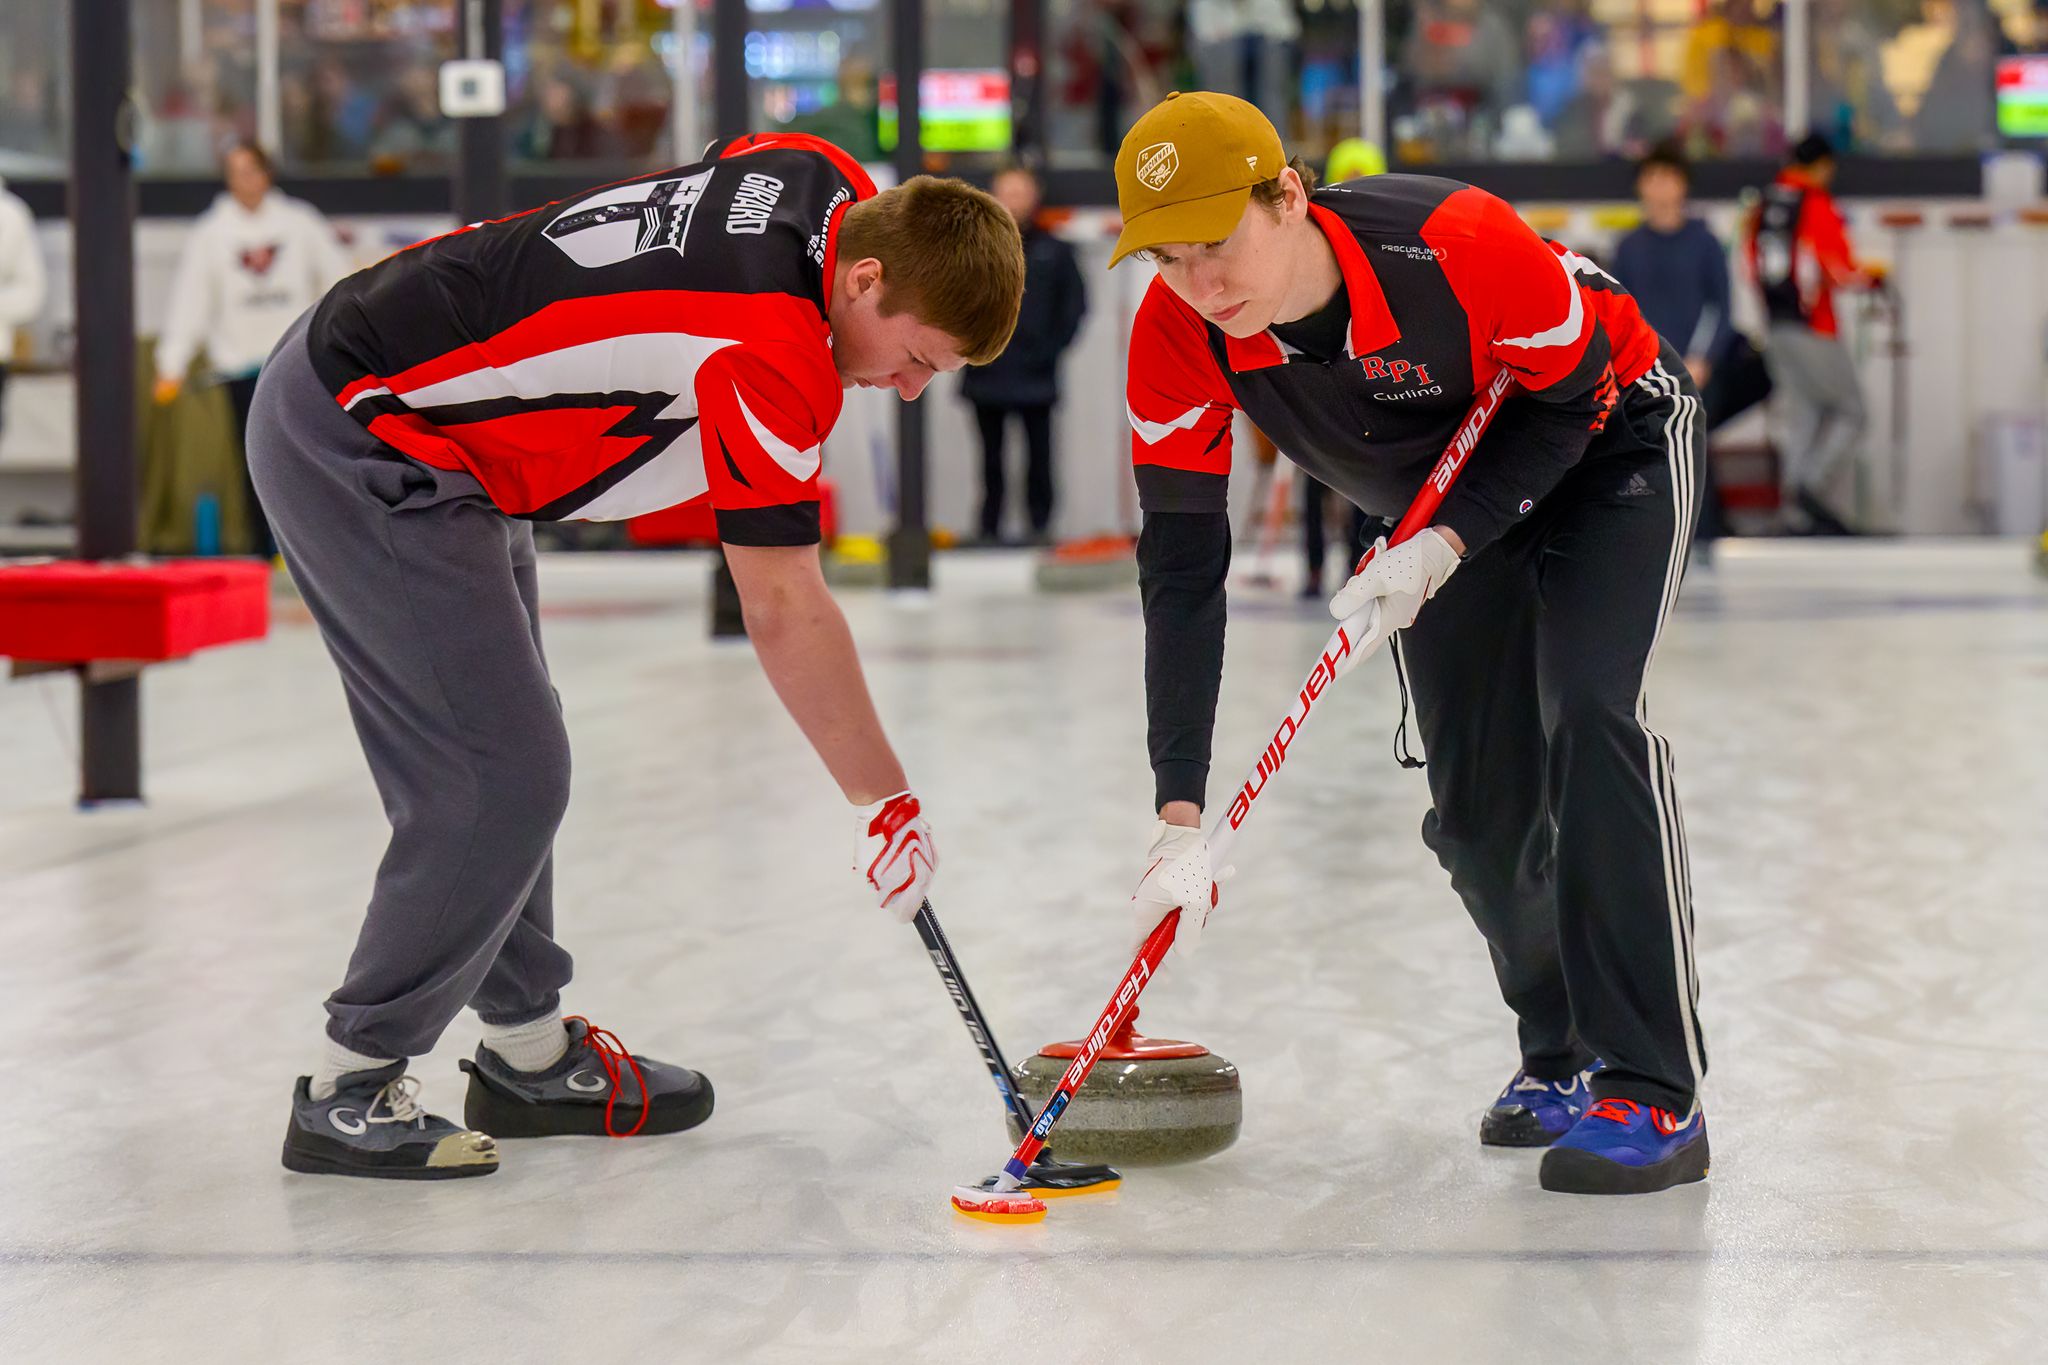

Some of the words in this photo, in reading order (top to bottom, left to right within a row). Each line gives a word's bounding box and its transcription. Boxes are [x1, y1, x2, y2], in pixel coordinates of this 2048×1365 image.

[1141, 152, 1149, 162] FC
[725, 173, 785, 235] GIRARD
[1381, 244, 1440, 257] PROCURLING
[1407, 253, 1433, 261] WEAR
[1359, 356, 1434, 386] RPI
[1373, 384, 1443, 401] Curling
[1434, 366, 1515, 494] ardline
[1226, 626, 1351, 831] Hardline
[1068, 957, 1150, 1087] Hardline
